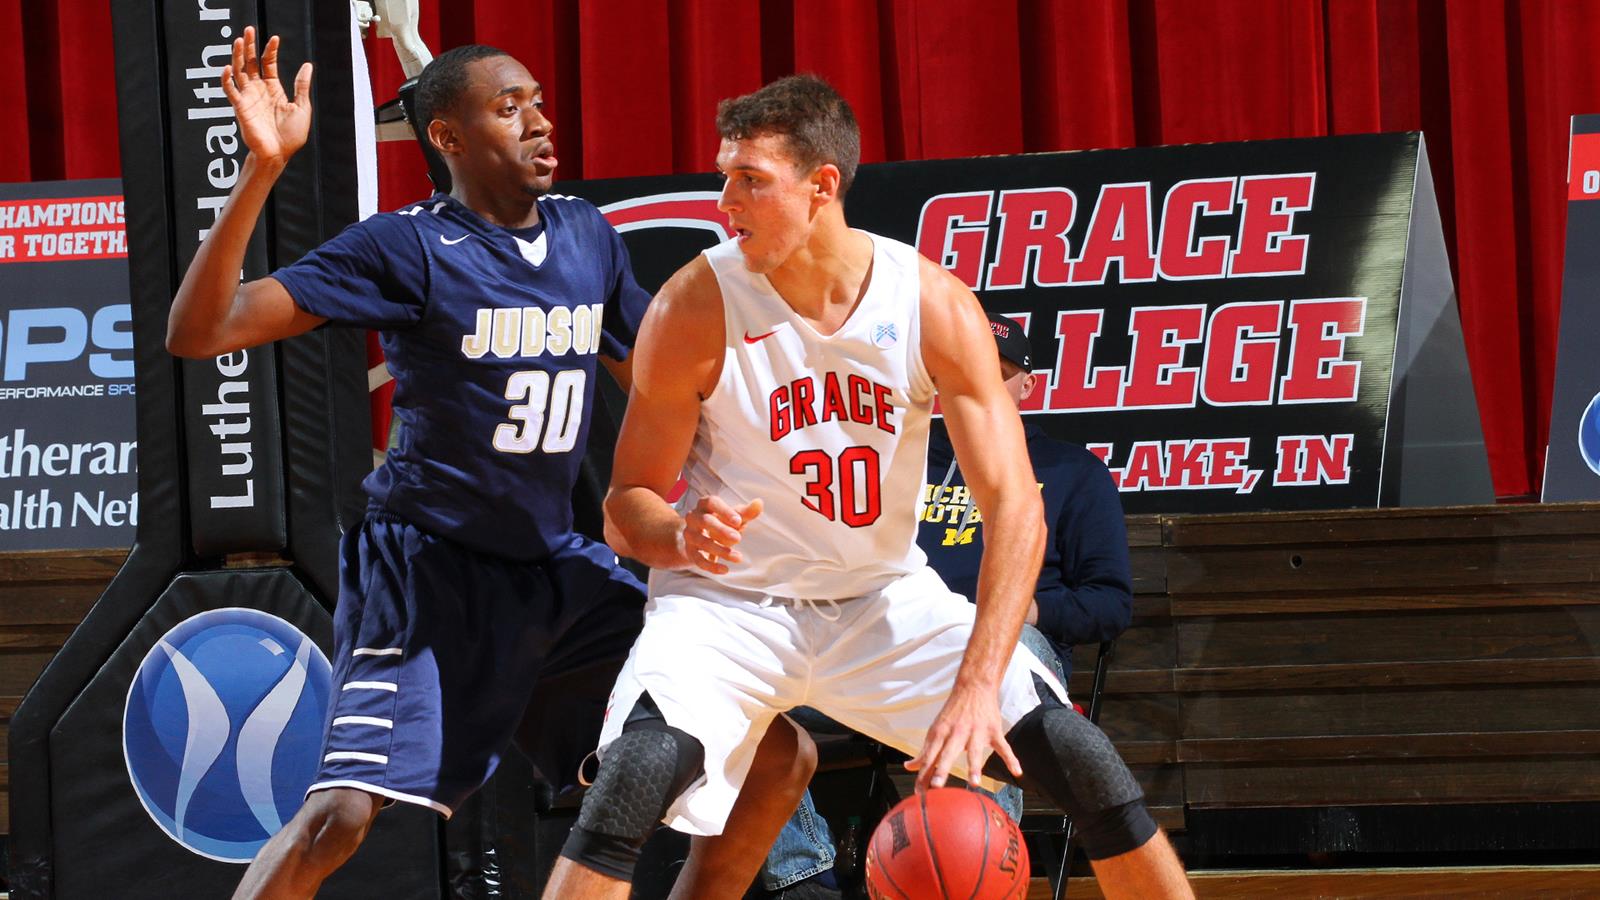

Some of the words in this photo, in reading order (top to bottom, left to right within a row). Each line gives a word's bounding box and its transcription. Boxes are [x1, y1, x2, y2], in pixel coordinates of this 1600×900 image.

[24, 230, 128, 257] TOGETH
[916, 172, 1317, 292] GRACE
[0, 304, 135, 382] PS
[492, 369, 587, 454] 30
[769, 371, 896, 442] GRACE
[789, 445, 882, 528] 30
[1273, 434, 1355, 488] IN
